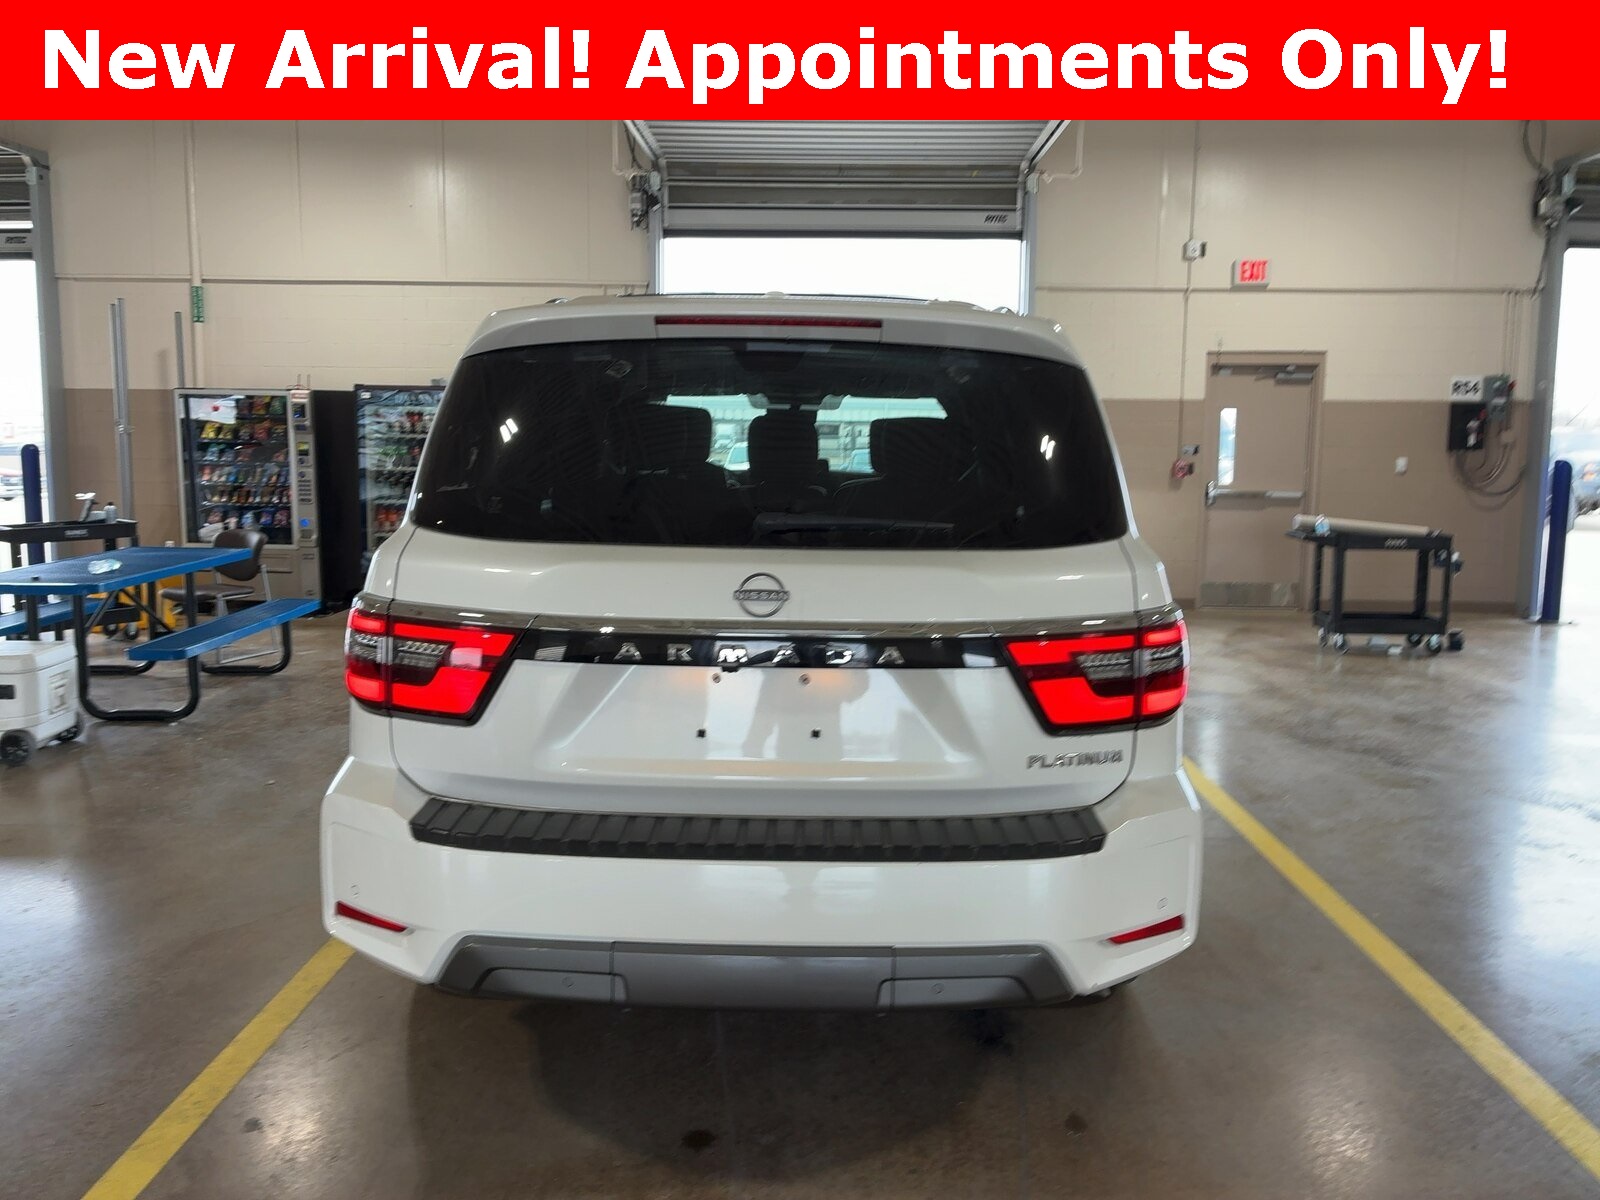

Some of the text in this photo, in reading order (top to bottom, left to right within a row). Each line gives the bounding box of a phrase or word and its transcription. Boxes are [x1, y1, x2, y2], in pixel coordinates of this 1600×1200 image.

[1240, 260, 1267, 281] EXIT
[735, 590, 789, 600] NISSAN
[613, 641, 905, 664] ARMADA
[1026, 750, 1123, 769] PLATINUM
